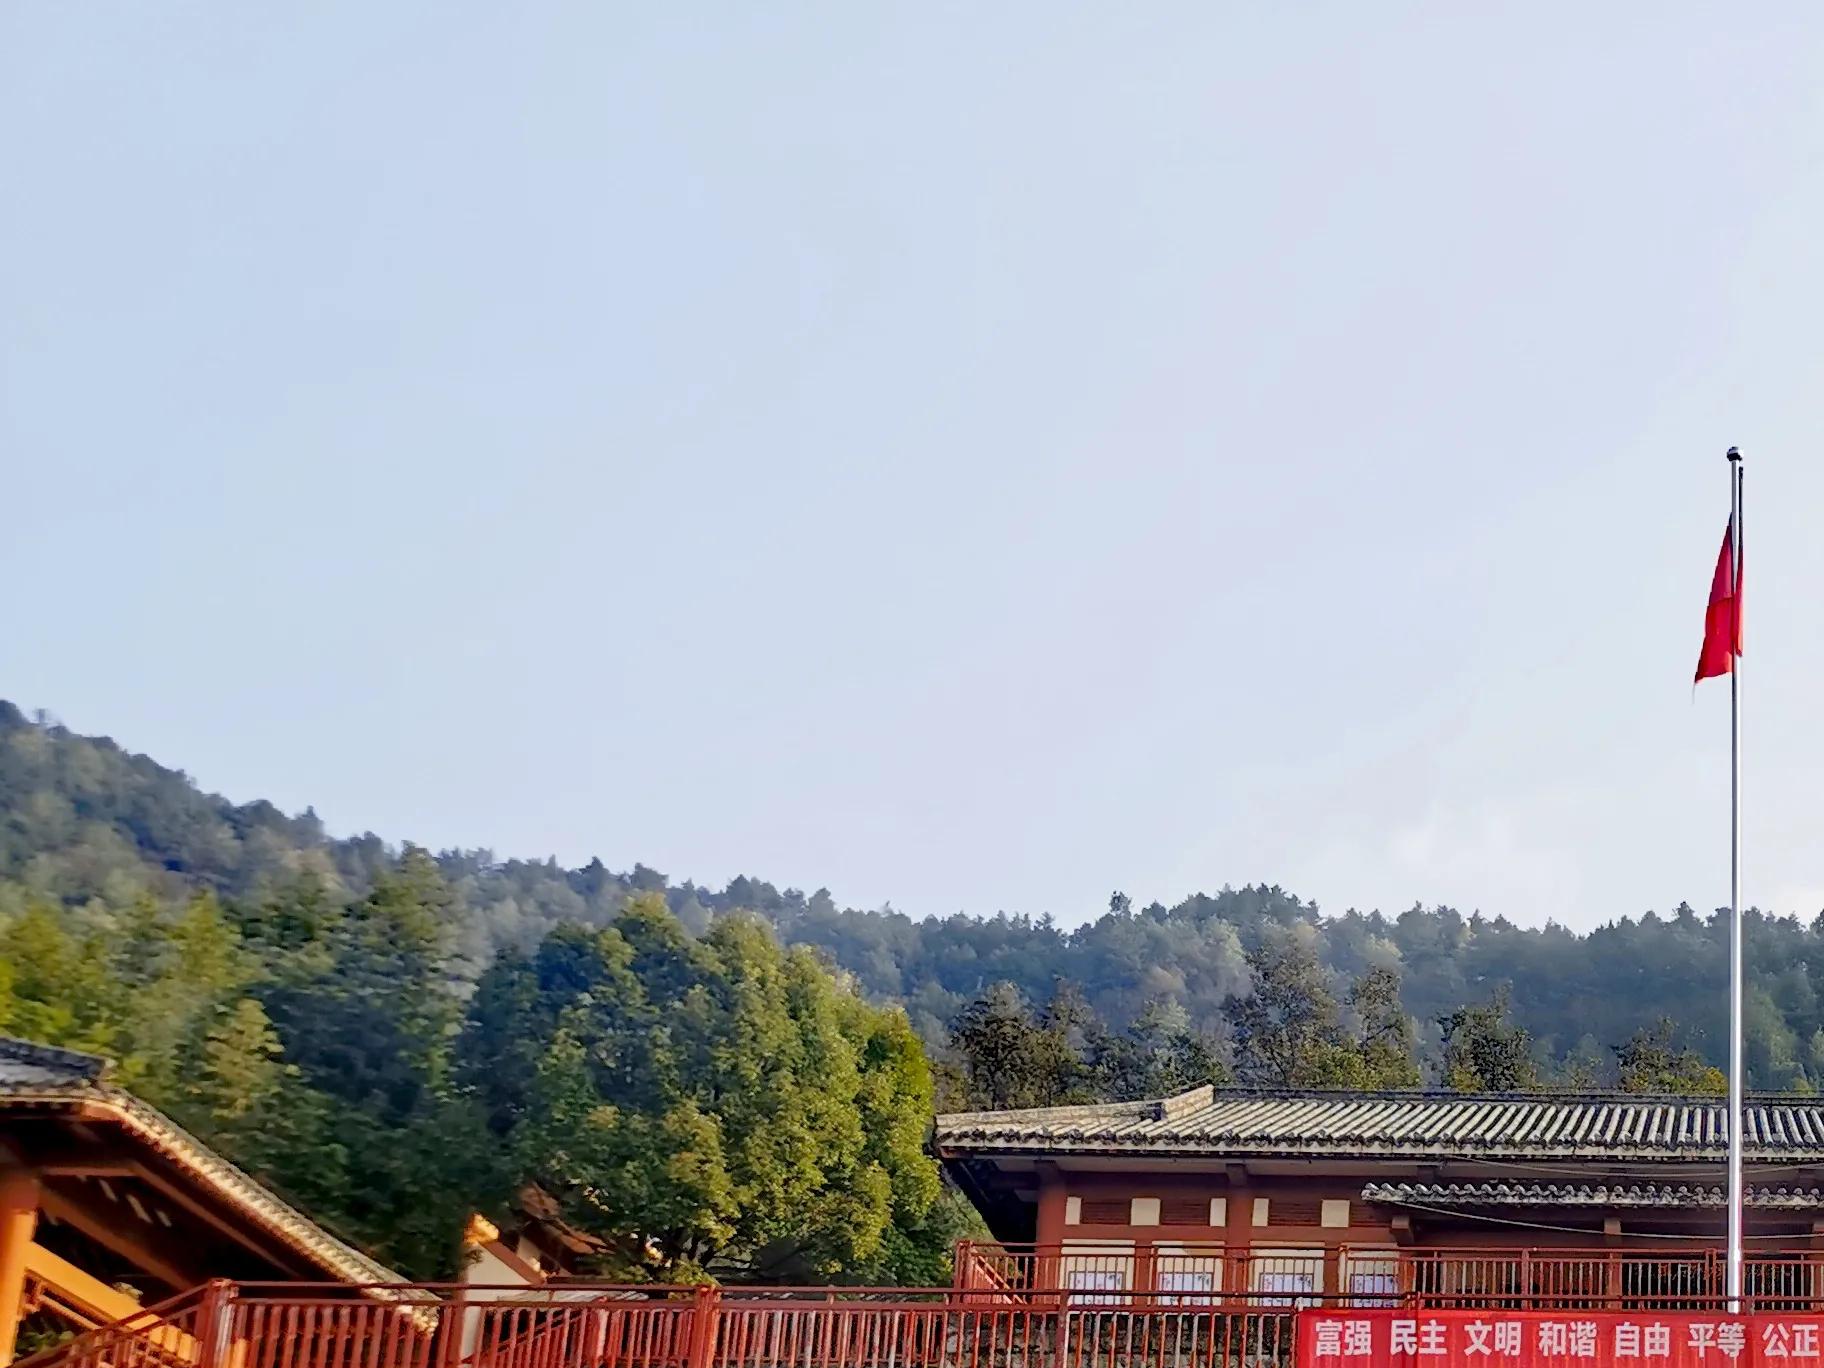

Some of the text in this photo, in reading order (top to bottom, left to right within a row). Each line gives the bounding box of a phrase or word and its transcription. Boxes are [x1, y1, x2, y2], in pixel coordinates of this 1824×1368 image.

[1314, 1321, 1372, 1356] 富强
[1390, 1321, 1448, 1356] 民主
[1464, 1321, 1522, 1356] 文明
[1538, 1322, 1597, 1357] 和谐
[1615, 1322, 1670, 1357] 自由
[1687, 1322, 1747, 1358] 平等
[1762, 1322, 1821, 1358] 公正
